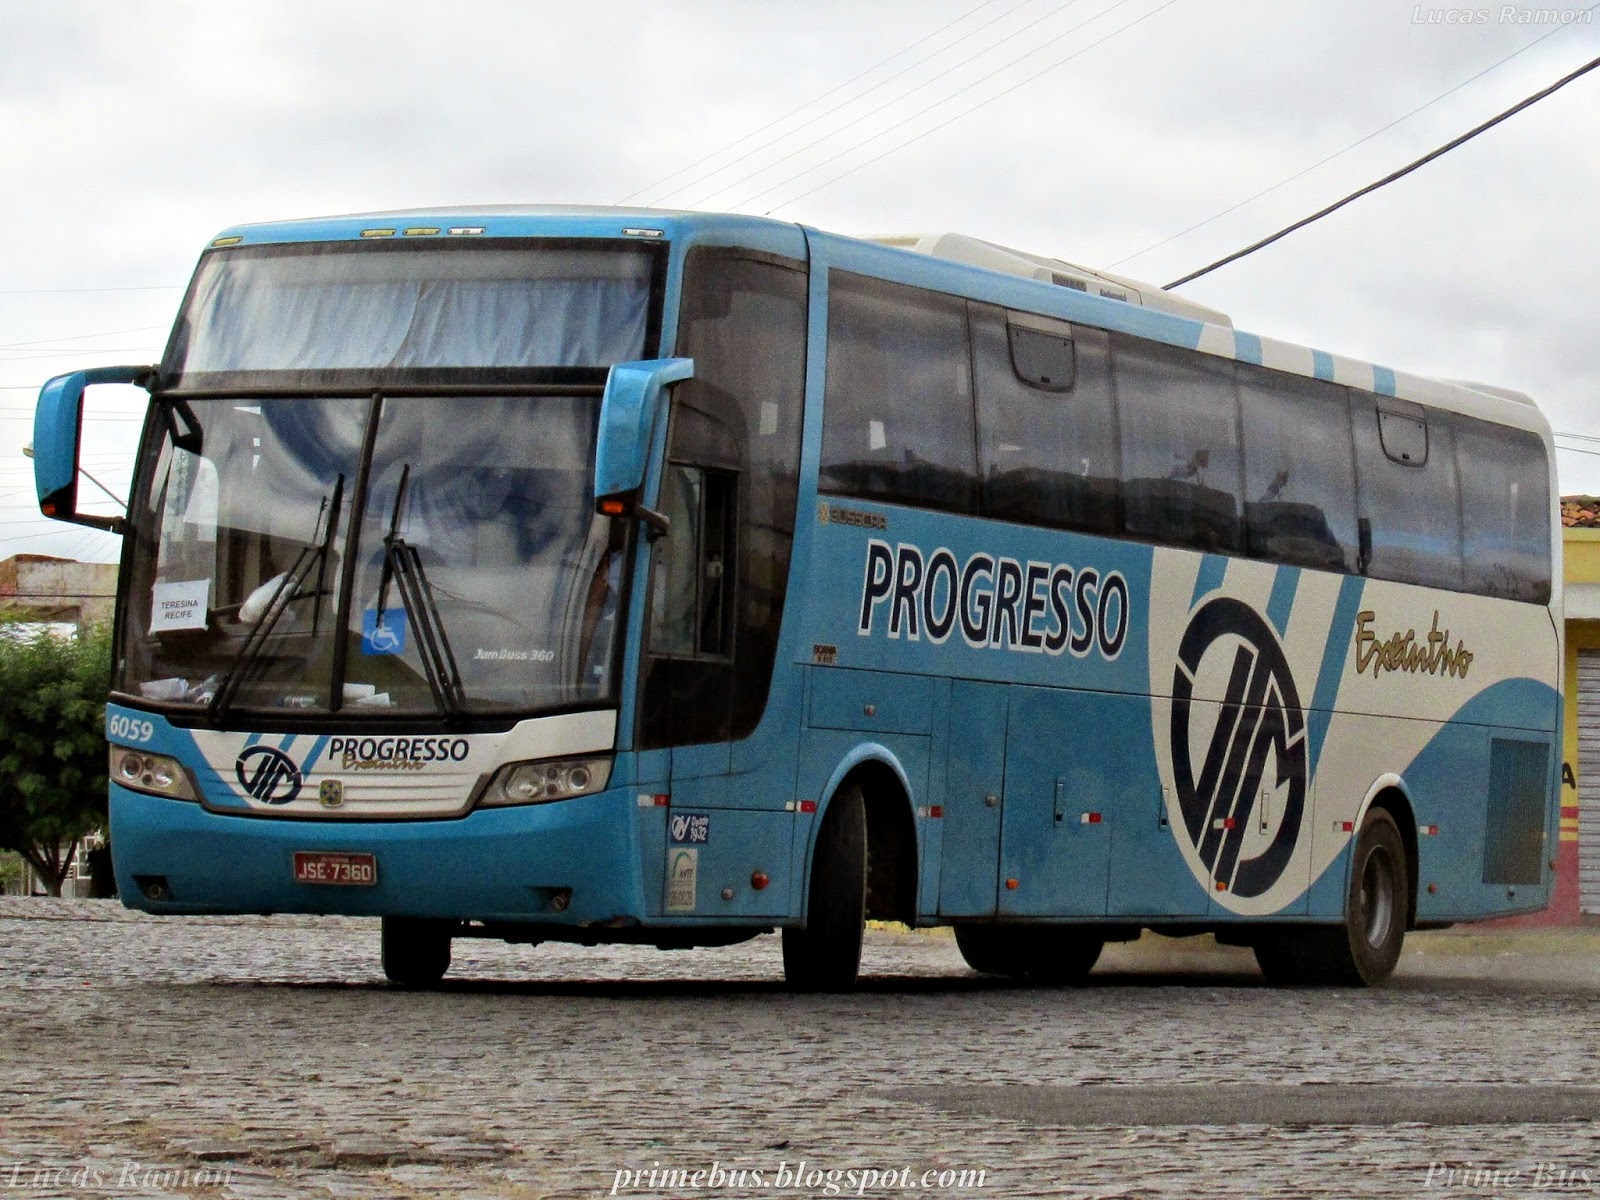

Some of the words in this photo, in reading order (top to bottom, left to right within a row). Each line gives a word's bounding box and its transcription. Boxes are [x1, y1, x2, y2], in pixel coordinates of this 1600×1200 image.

[161, 600, 199, 609] TERESINA
[857, 538, 1130, 661] PROGRESSO
[165, 610, 193, 619] RECIFE
[1355, 609, 1474, 679] Executivo
[530, 649, 555, 661] 360
[110, 714, 154, 742] 6059
[328, 737, 470, 761] PROGRESSO
[298, 862, 327, 880] JSE
[330, 863, 372, 881] 7360
